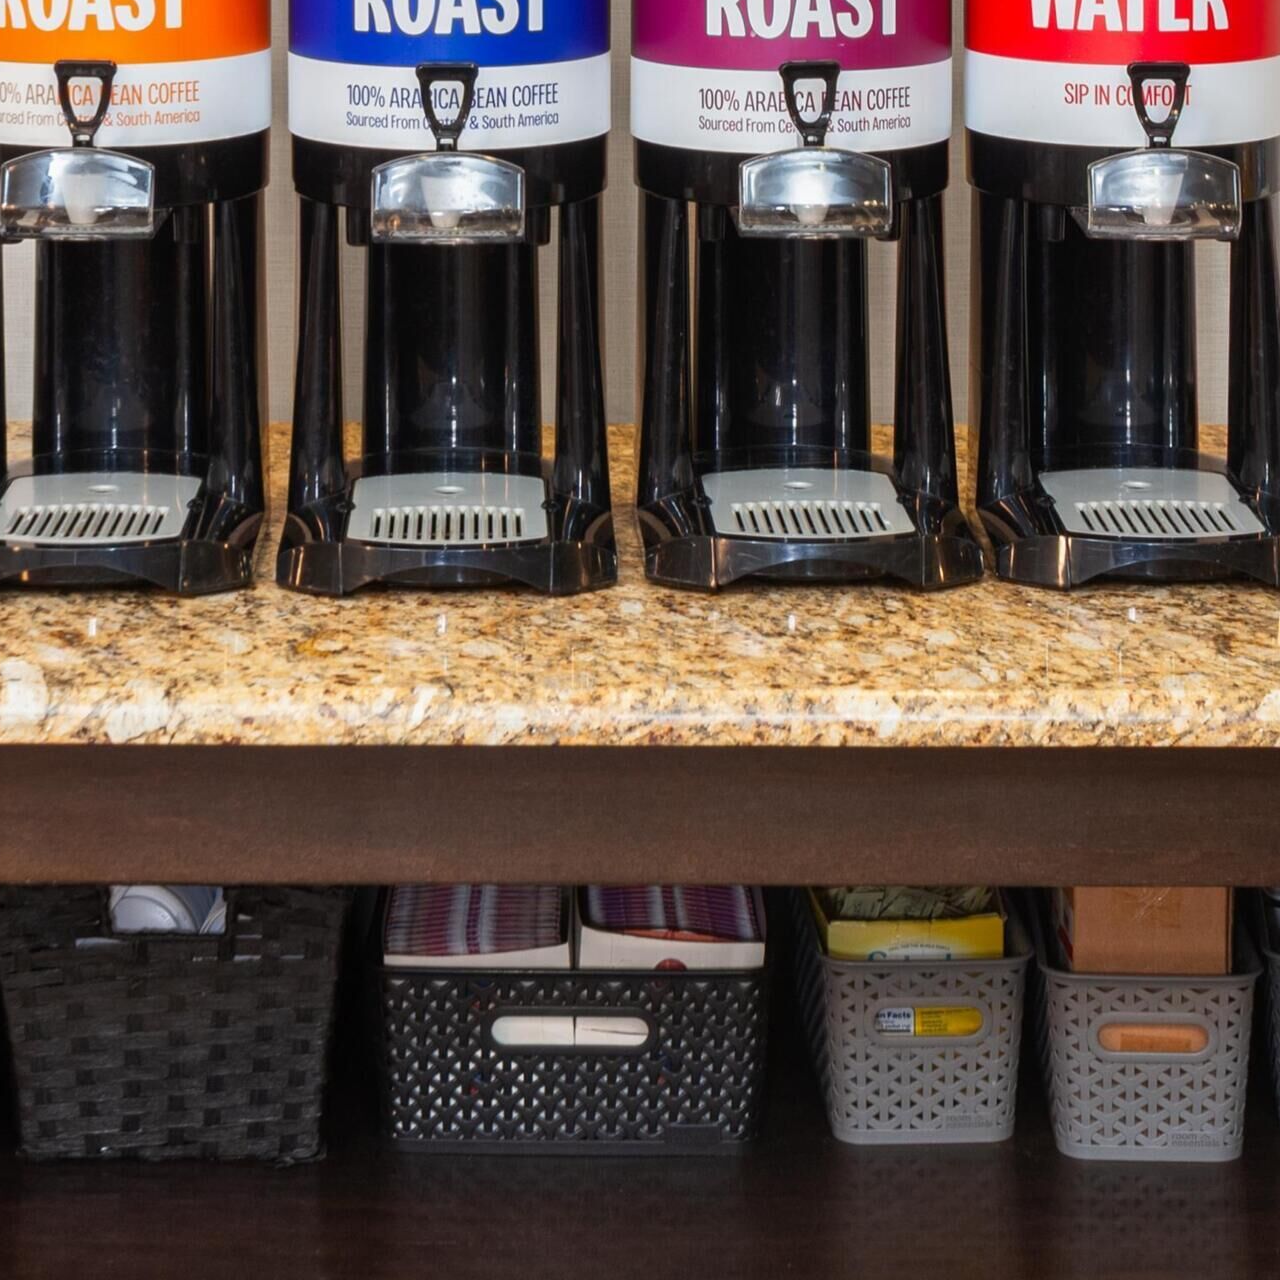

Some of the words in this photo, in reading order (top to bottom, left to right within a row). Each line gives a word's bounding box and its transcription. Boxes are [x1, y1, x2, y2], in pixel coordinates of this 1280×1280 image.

[102, 83, 143, 106] EAN
[148, 80, 200, 104] COFFEE
[346, 84, 385, 107] 100%
[390, 86, 460, 109] ARAICA
[512, 82, 559, 107] COFFEE
[698, 88, 740, 111] 100%
[744, 90, 816, 113] ARABCA
[867, 86, 910, 109] COFFEE
[1064, 83, 1089, 105] SIP
[1094, 85, 1110, 106] IN
[1116, 84, 1192, 106] COMFOT
[27, 110, 55, 126] From
[116, 110, 151, 126] South
[154, 109, 200, 124] America
[346, 111, 388, 128] Sourced
[391, 114, 420, 129] From
[470, 115, 480, 130] &
[482, 113, 516, 129] South
[518, 111, 559, 128] America
[698, 115, 743, 132] Sourced
[746, 117, 775, 133] From
[837, 116, 870, 132] South
[872, 114, 911, 130] America
[887, 1011, 911, 1019] Facts
